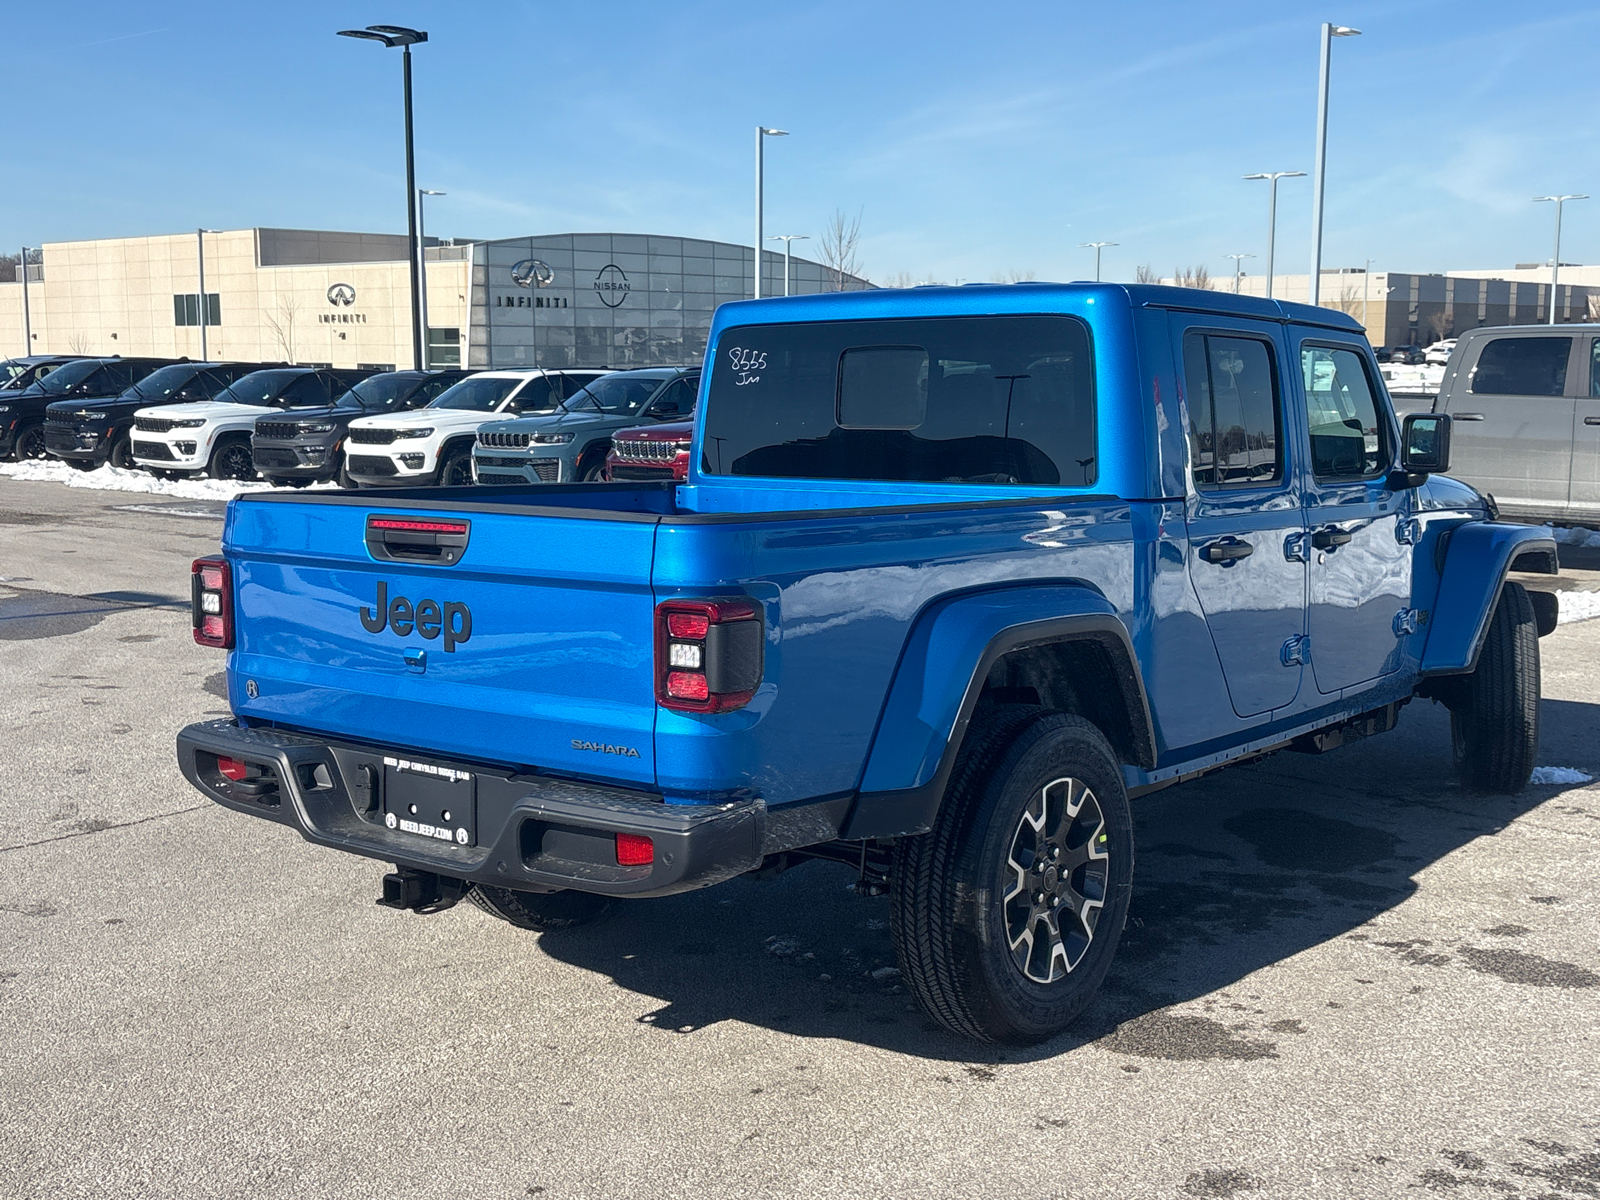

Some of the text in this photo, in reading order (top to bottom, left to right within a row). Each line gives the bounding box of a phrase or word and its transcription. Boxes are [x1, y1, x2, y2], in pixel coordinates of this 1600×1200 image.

[593, 282, 631, 291] NISSAN
[497, 296, 568, 308] INFINITI
[318, 313, 367, 324] INFINITI
[729, 347, 768, 370] 8555
[360, 581, 472, 653] Jeep
[571, 739, 641, 758] SAHARA
[399, 760, 411, 769] JEEP
[411, 762, 437, 774] CHRYSLER
[456, 770, 470, 781] RAM
